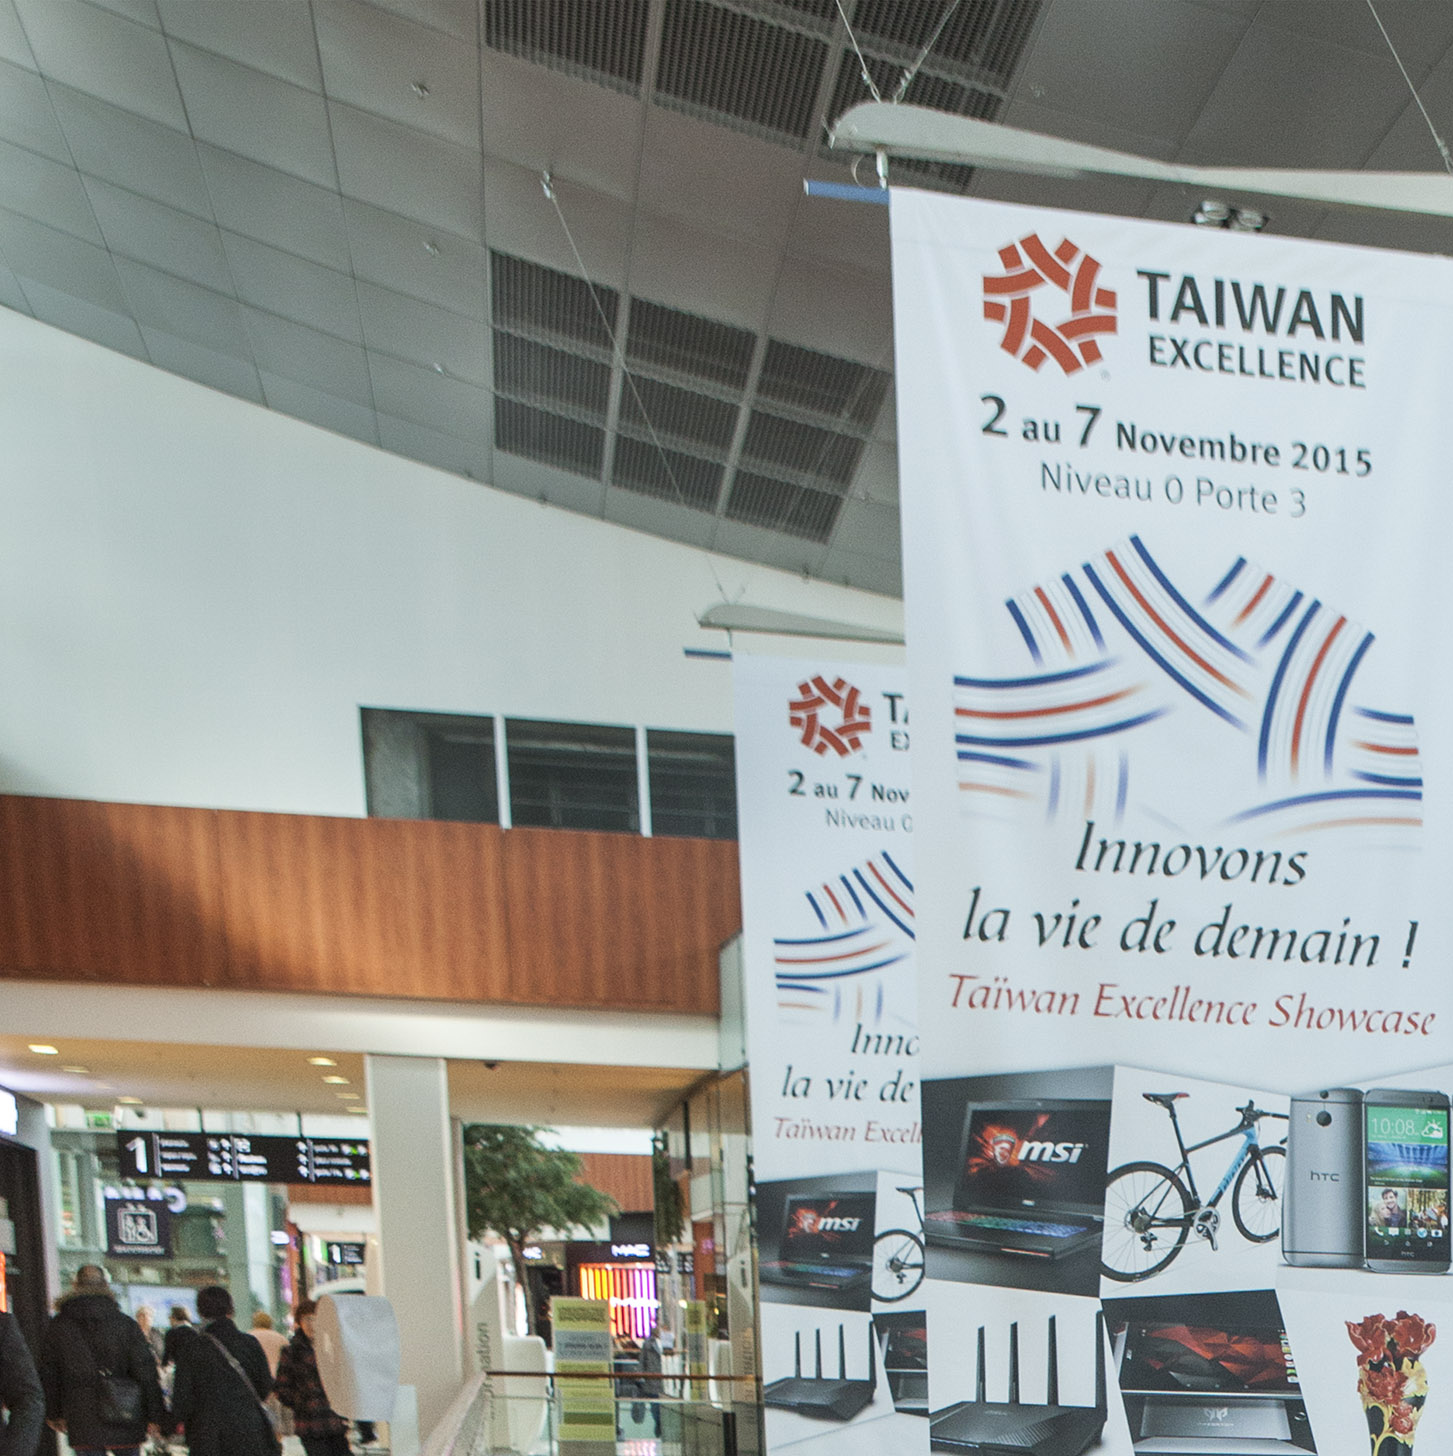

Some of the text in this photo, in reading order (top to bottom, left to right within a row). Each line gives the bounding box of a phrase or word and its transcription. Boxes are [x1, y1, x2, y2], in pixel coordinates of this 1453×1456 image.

[1136, 269, 1365, 345] TAIWAN
[1148, 334, 1366, 389] EXCELLENCE
[980, 394, 1373, 477] 2 au 7 Novembre 2015
[1041, 461, 1306, 518] Niveau 0 Porte 3
[788, 768, 806, 796] 2
[814, 783, 838, 799] au
[846, 773, 862, 801] 7
[826, 808, 895, 832] Niveau
[1075, 820, 1308, 887] Innovons
[962, 886, 1418, 969] la vie de demain !
[949, 973, 1436, 1036] Taïwan Excellence Showcase
[782, 1063, 914, 1102] la vie de
[1017, 1140, 1084, 1163] msi
